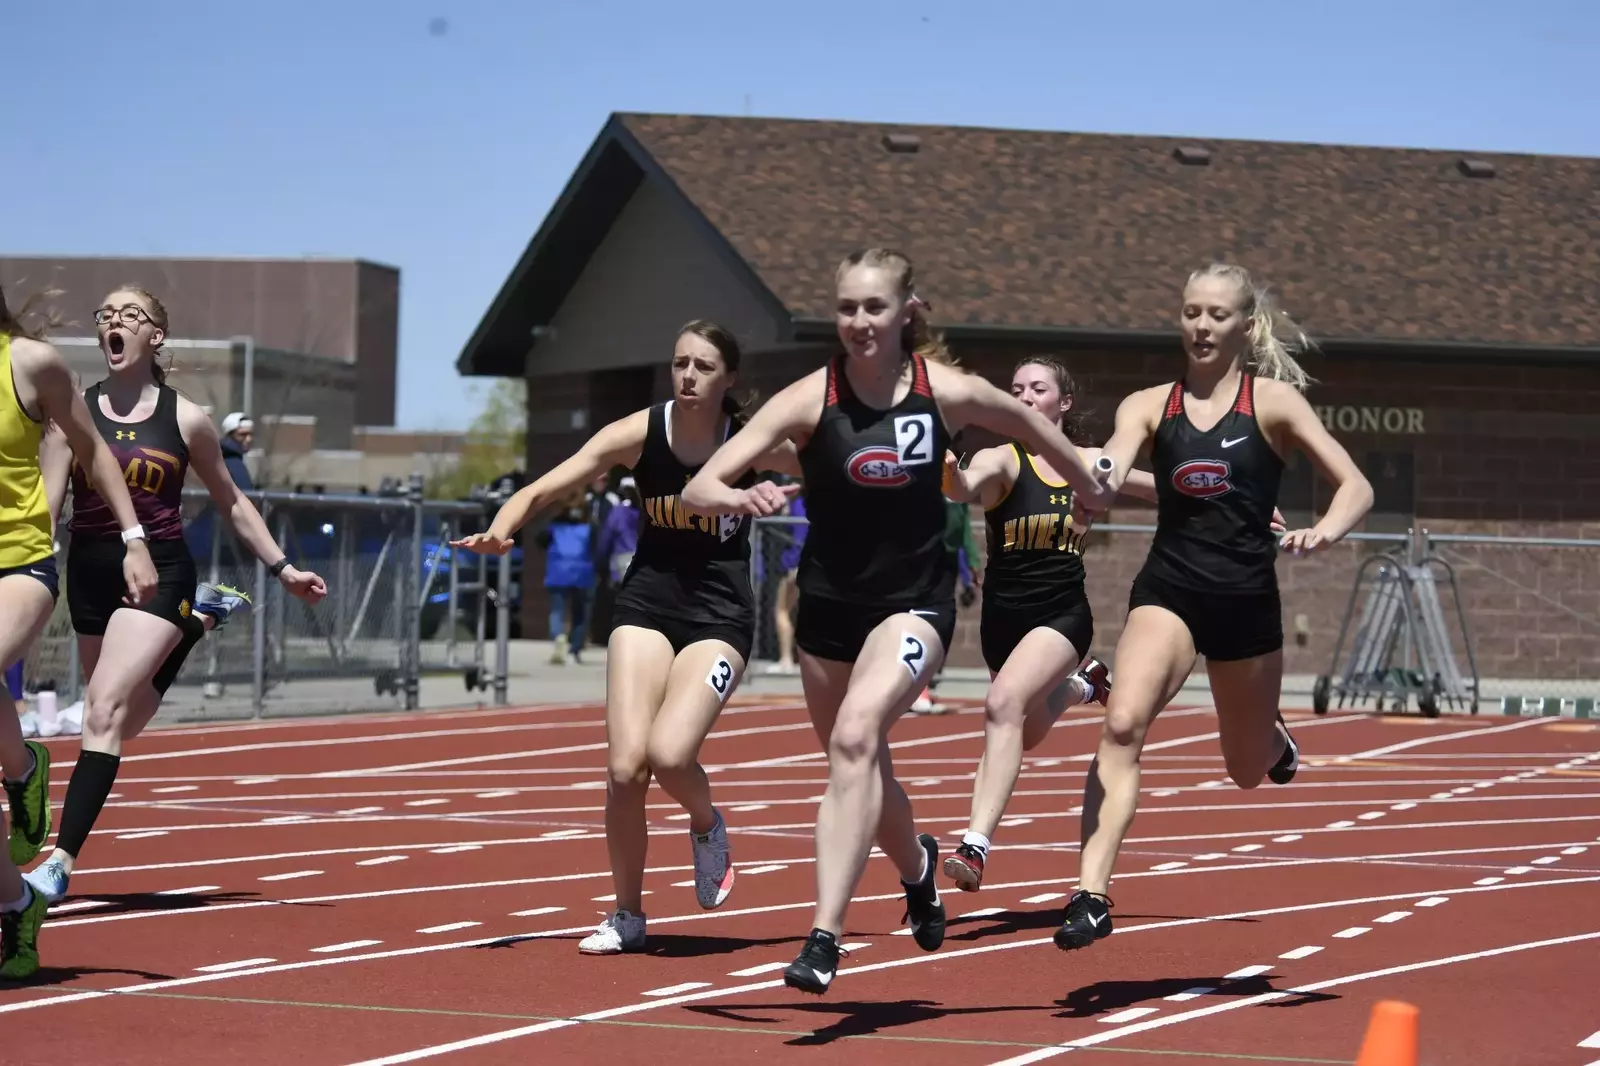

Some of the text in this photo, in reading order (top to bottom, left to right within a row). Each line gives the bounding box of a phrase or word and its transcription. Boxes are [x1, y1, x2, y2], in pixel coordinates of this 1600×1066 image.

[1313, 405, 1425, 433] HONOR
[901, 419, 927, 461] 2
[902, 636, 923, 675] 2
[711, 660, 731, 693] 3
